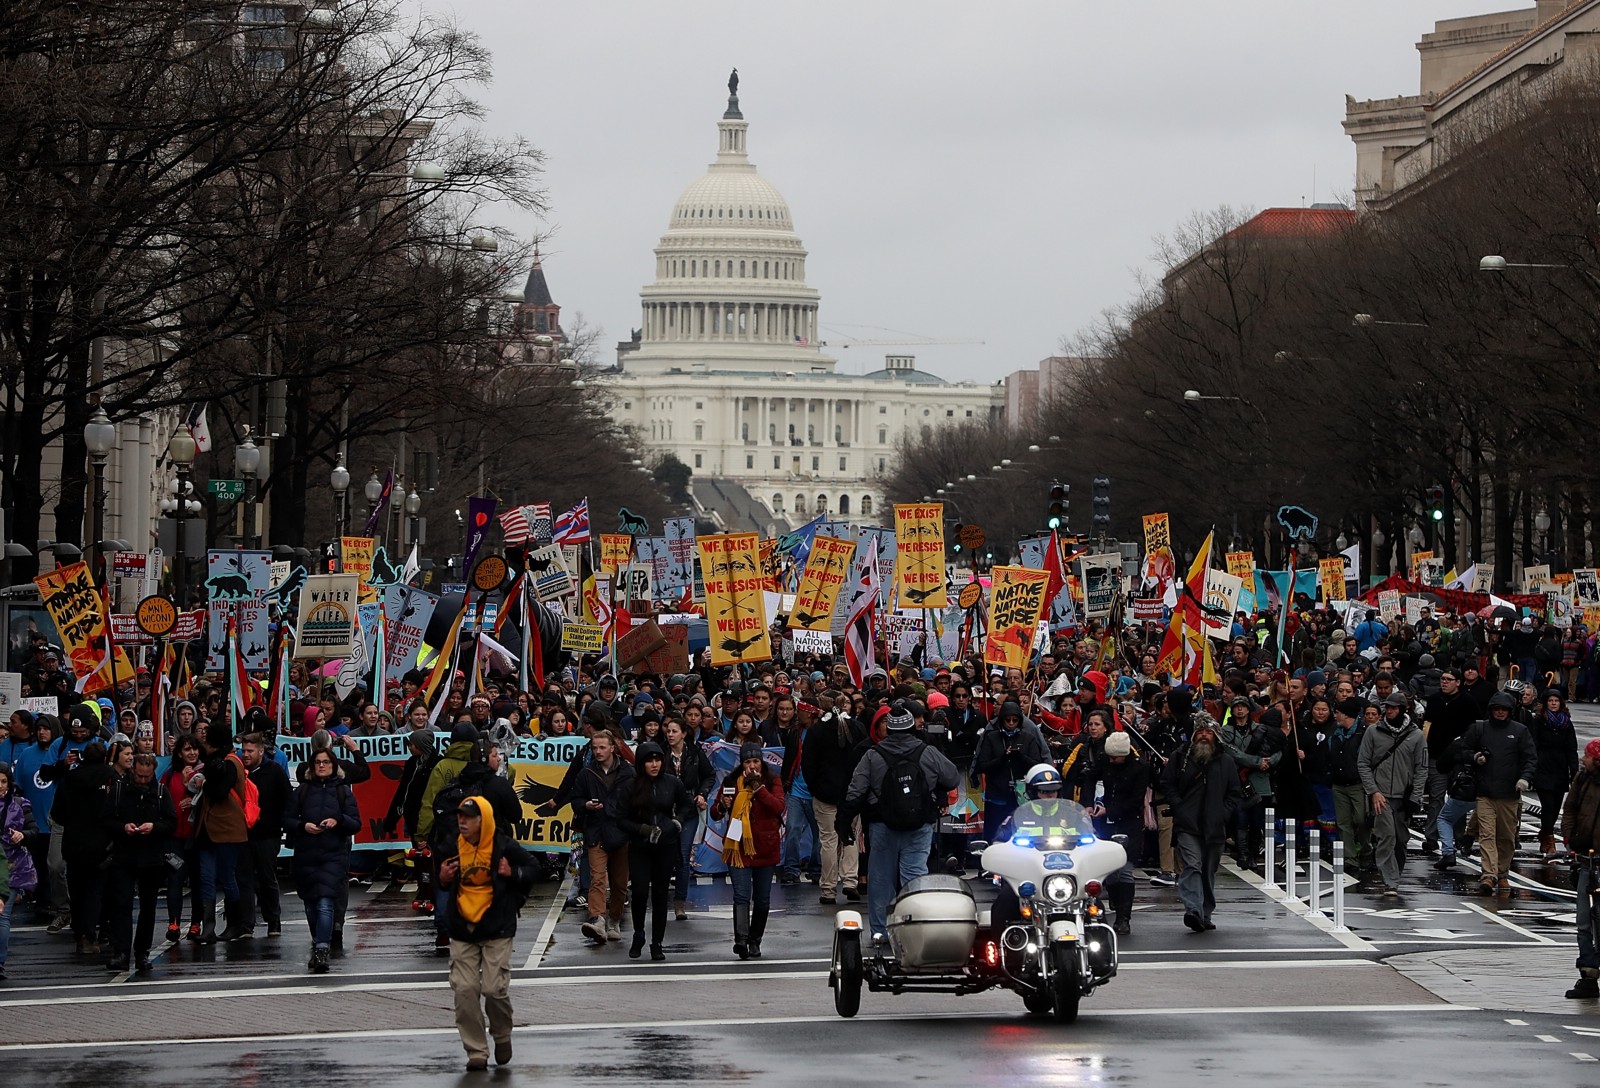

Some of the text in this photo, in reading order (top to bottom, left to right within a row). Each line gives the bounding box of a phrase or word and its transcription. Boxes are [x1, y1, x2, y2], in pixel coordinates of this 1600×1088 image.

[215, 482, 227, 492] 12
[899, 510, 940, 524] WE EXIST
[1146, 519, 1166, 537] NATIVE
[343, 540, 372, 548] WE EXIST
[702, 538, 755, 553] WE EXIST
[816, 540, 852, 555] WE EXIST
[898, 543, 944, 557] WE RESIST
[1148, 539, 1168, 554] RISE
[477, 573, 503, 582] MEETING
[804, 567, 844, 585] WE RESIST
[904, 572, 940, 584] WE RISE
[706, 582, 724, 594] WE
[727, 577, 765, 592] RESIST
[996, 582, 1045, 602] NATIVE
[312, 592, 349, 603] WATER
[1089, 590, 1110, 598] PROTECT
[148, 604, 163, 613] MNI
[212, 600, 267, 611] INDGENOUS
[800, 597, 812, 607] WE
[813, 600, 831, 612] RISE
[995, 596, 1040, 614] NATIONS
[141, 613, 171, 623] WICONI
[316, 610, 340, 621] LIFE
[994, 608, 1038, 630] RISE
[63, 612, 103, 646] RISE
[717, 617, 760, 632] WE RISE
[580, 628, 602, 636] Colleges
[805, 631, 820, 639] ALL
[563, 639, 586, 648] Standing
[795, 637, 831, 647] NATIONS
[797, 644, 832, 654] RISING
[515, 819, 571, 842] WE RI
